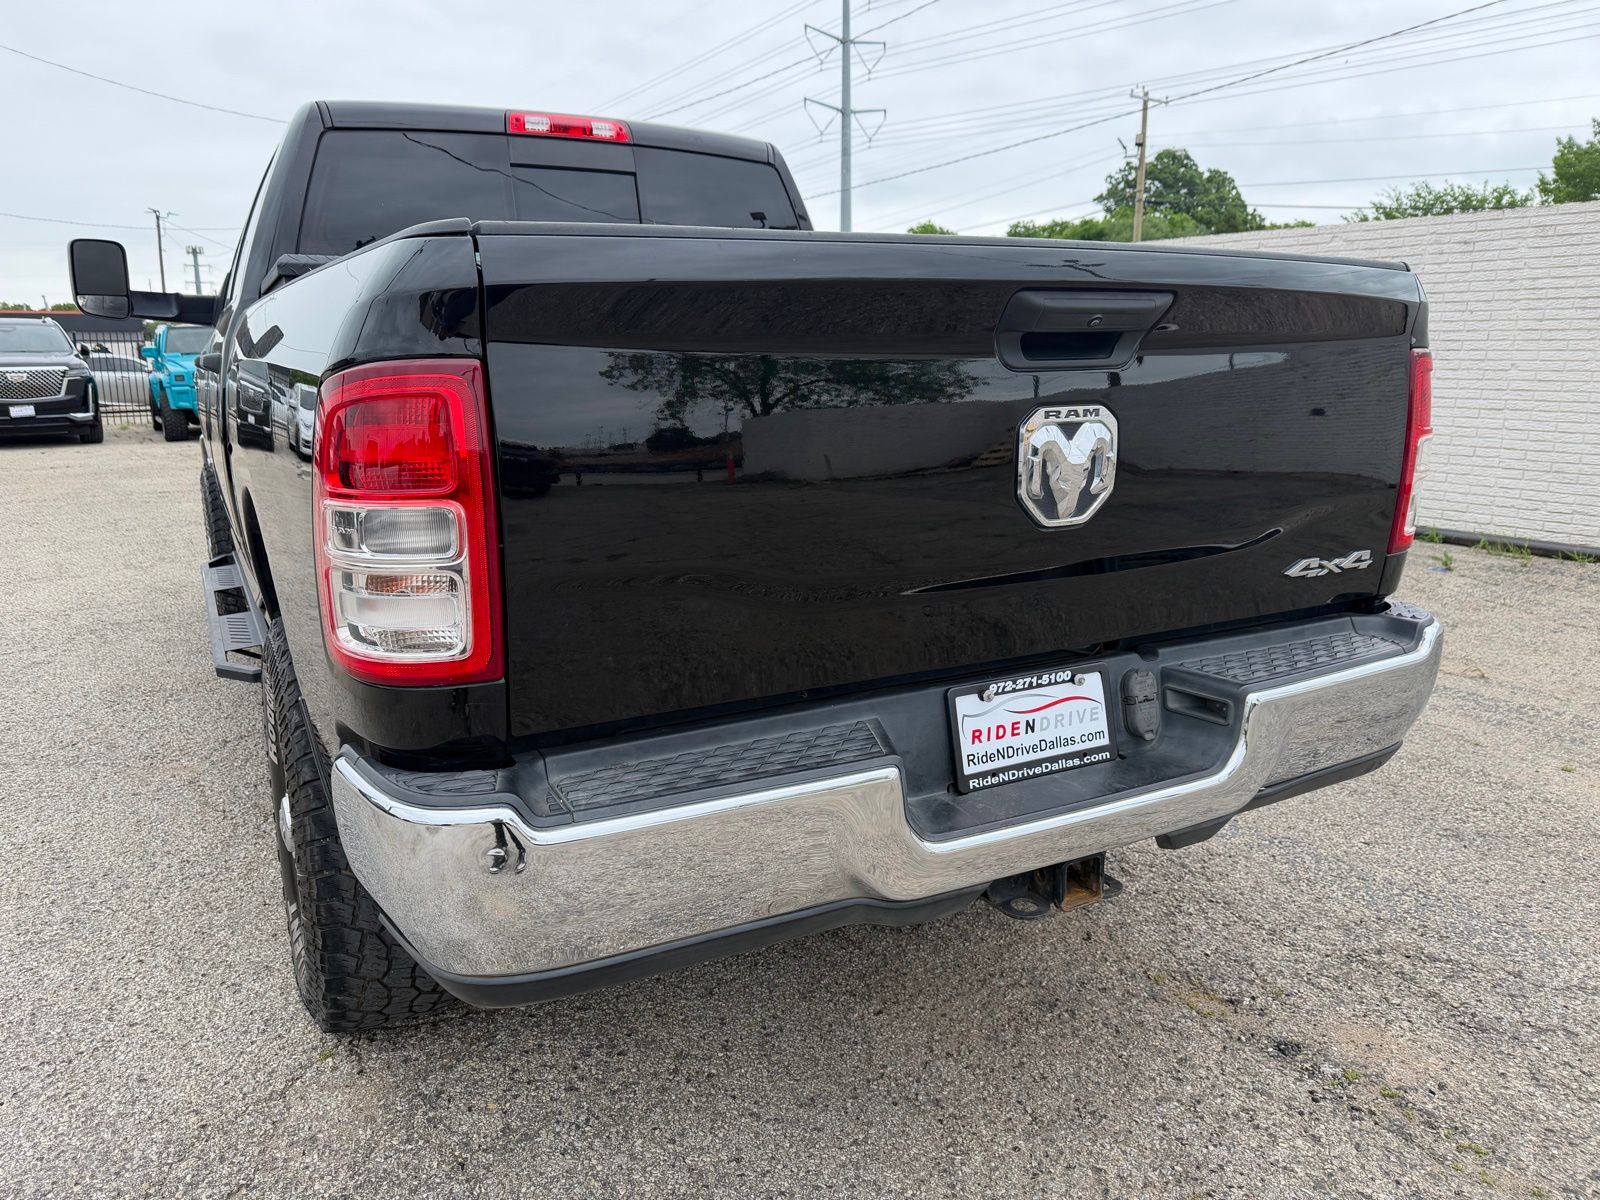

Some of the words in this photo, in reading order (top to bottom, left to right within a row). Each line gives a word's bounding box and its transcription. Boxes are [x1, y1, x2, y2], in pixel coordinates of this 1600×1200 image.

[1044, 408, 1100, 419] RAM
[989, 671, 1072, 692] 972-271-5100
[967, 729, 1105, 767] RideNDriveDallas.com
[969, 751, 1111, 789] RideNDriveDallas.com
